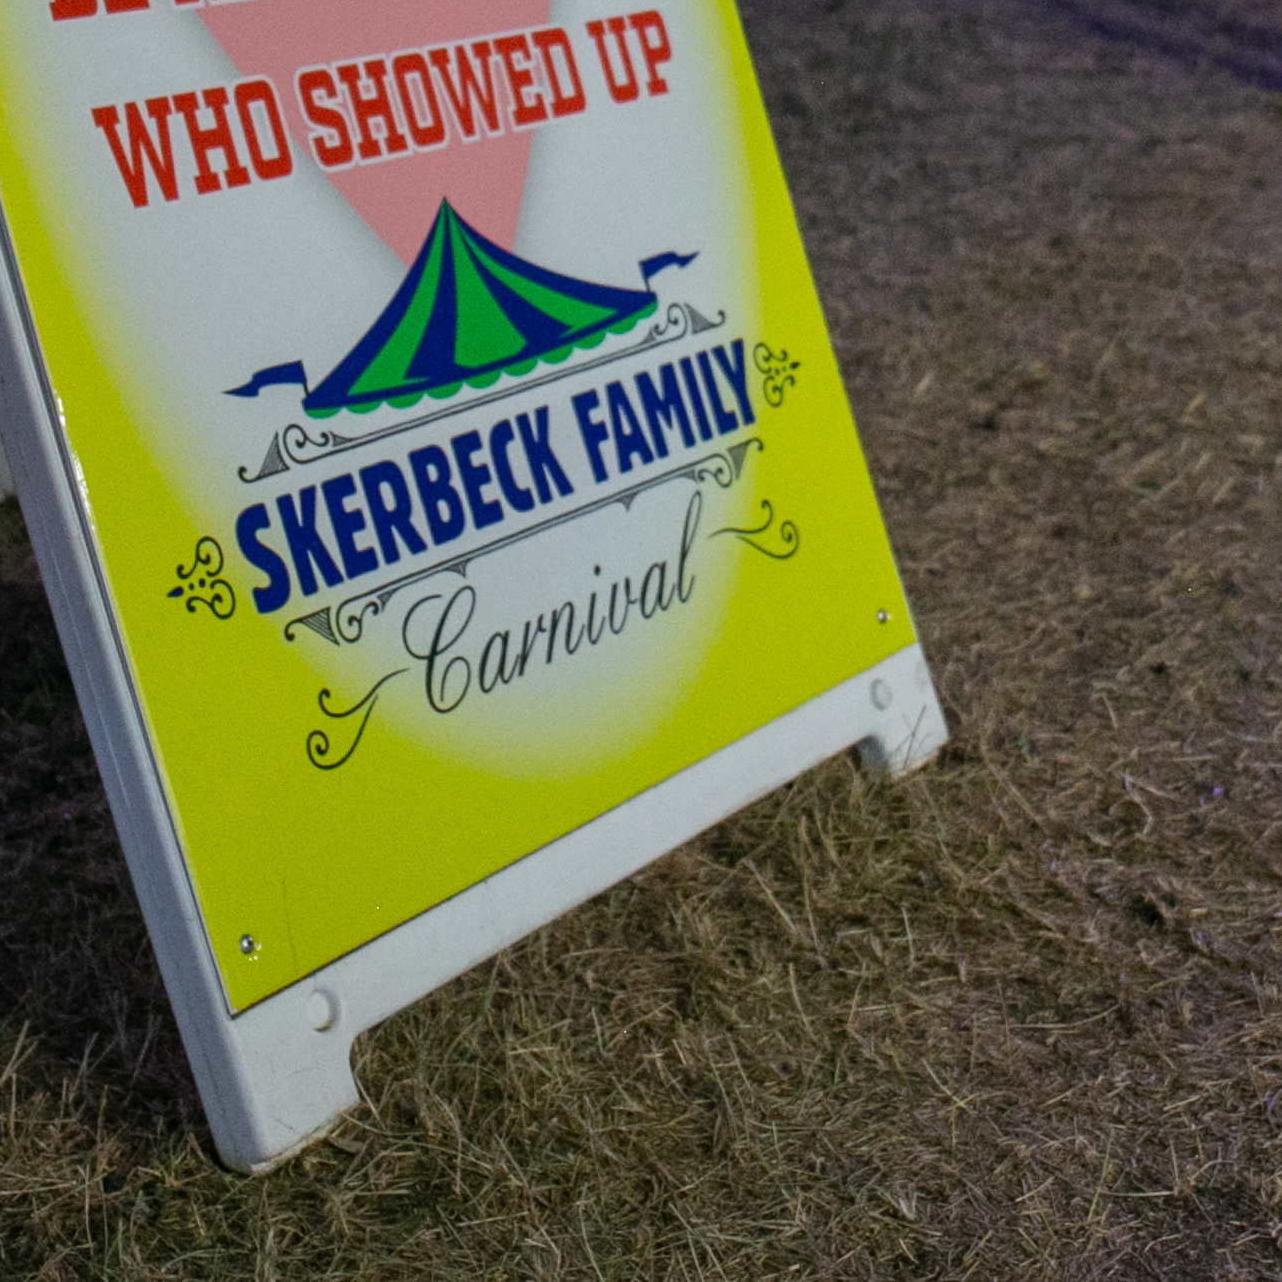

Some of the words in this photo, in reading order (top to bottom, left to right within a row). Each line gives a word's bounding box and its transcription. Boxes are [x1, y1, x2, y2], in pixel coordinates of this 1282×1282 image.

[91, 79, 293, 208] WHO
[298, 27, 586, 167] SHOWED
[586, 10, 672, 103] UP
[235, 406, 574, 613] SKERBECK
[571, 340, 754, 484] FAMILY
[401, 489, 704, 714] Carnival
